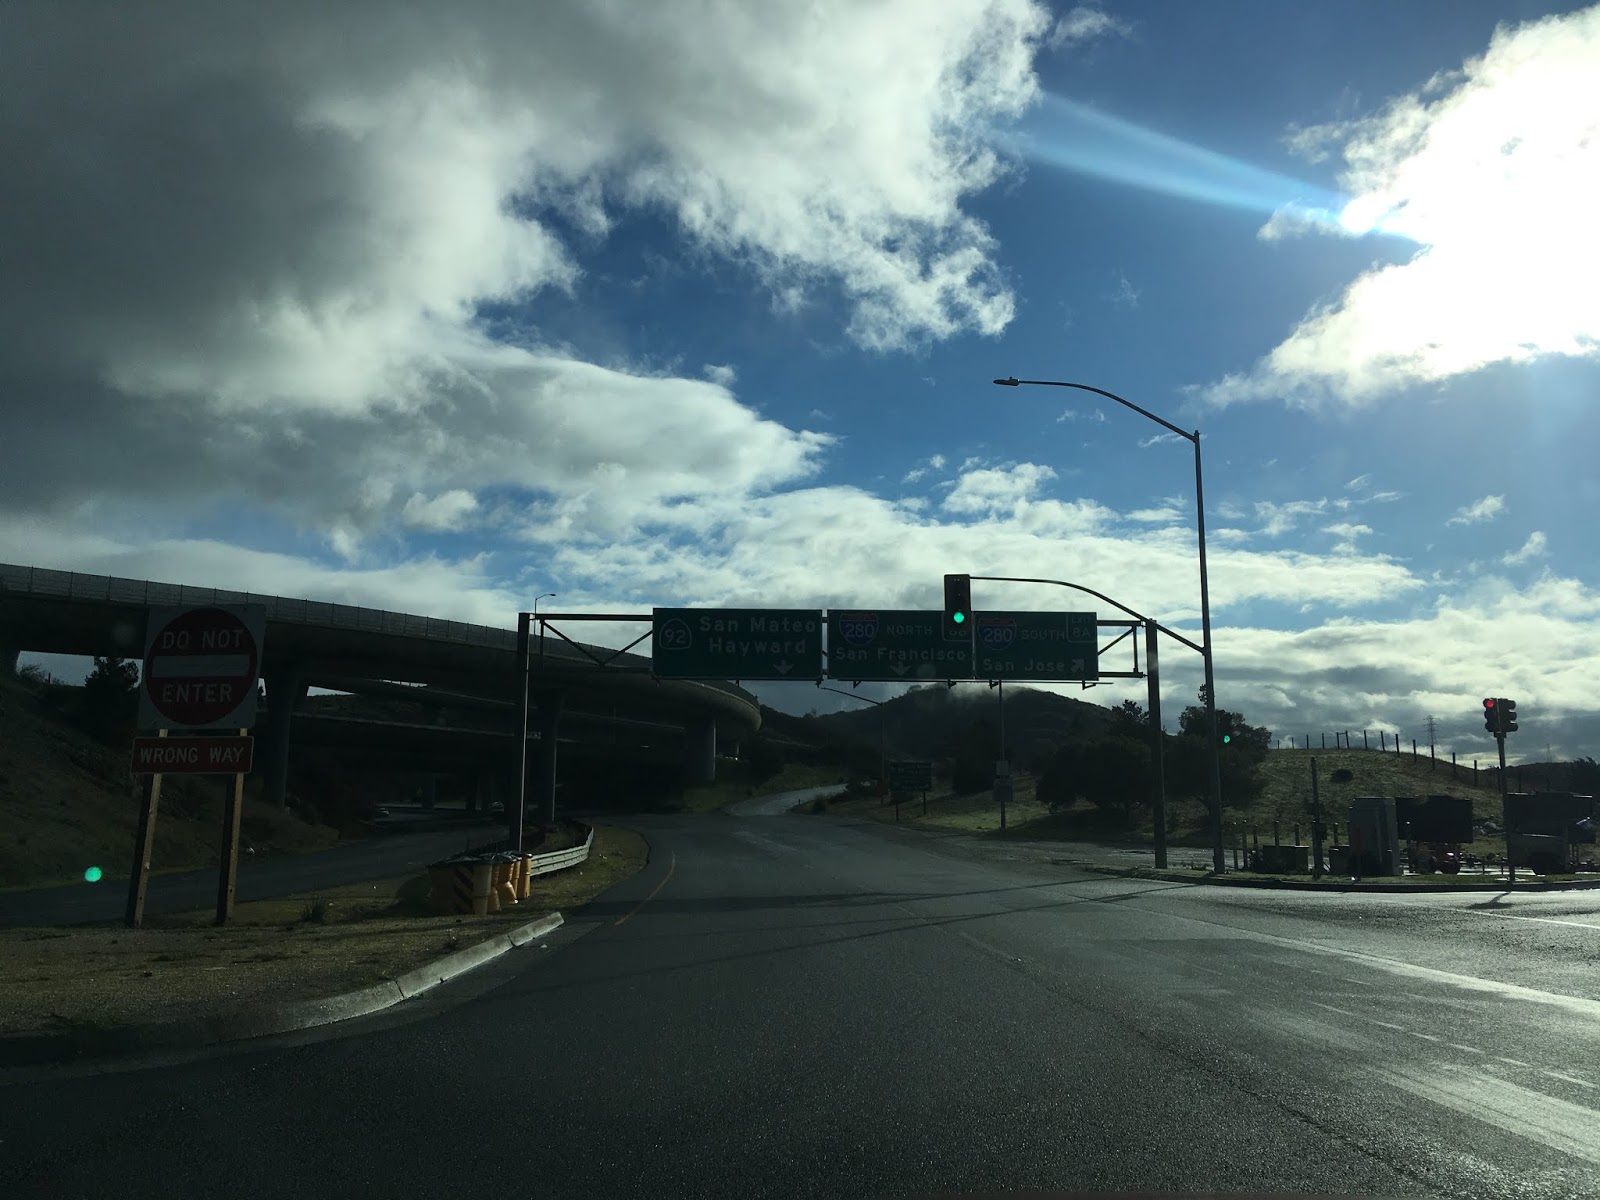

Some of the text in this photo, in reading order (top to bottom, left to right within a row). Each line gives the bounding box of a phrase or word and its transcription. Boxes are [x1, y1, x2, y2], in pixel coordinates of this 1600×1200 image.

[699, 616, 816, 633] San Mateo
[844, 623, 932, 639] 280 NORTH
[162, 628, 245, 650] DO NOT
[664, 630, 687, 645] 92
[983, 627, 1065, 642] 280 SOUTH
[709, 637, 806, 656] Hayward
[836, 647, 966, 661] San Francisco
[983, 658, 1065, 672] San Jose
[162, 683, 233, 703] ENTER
[140, 746, 245, 764] WRONG WAY
